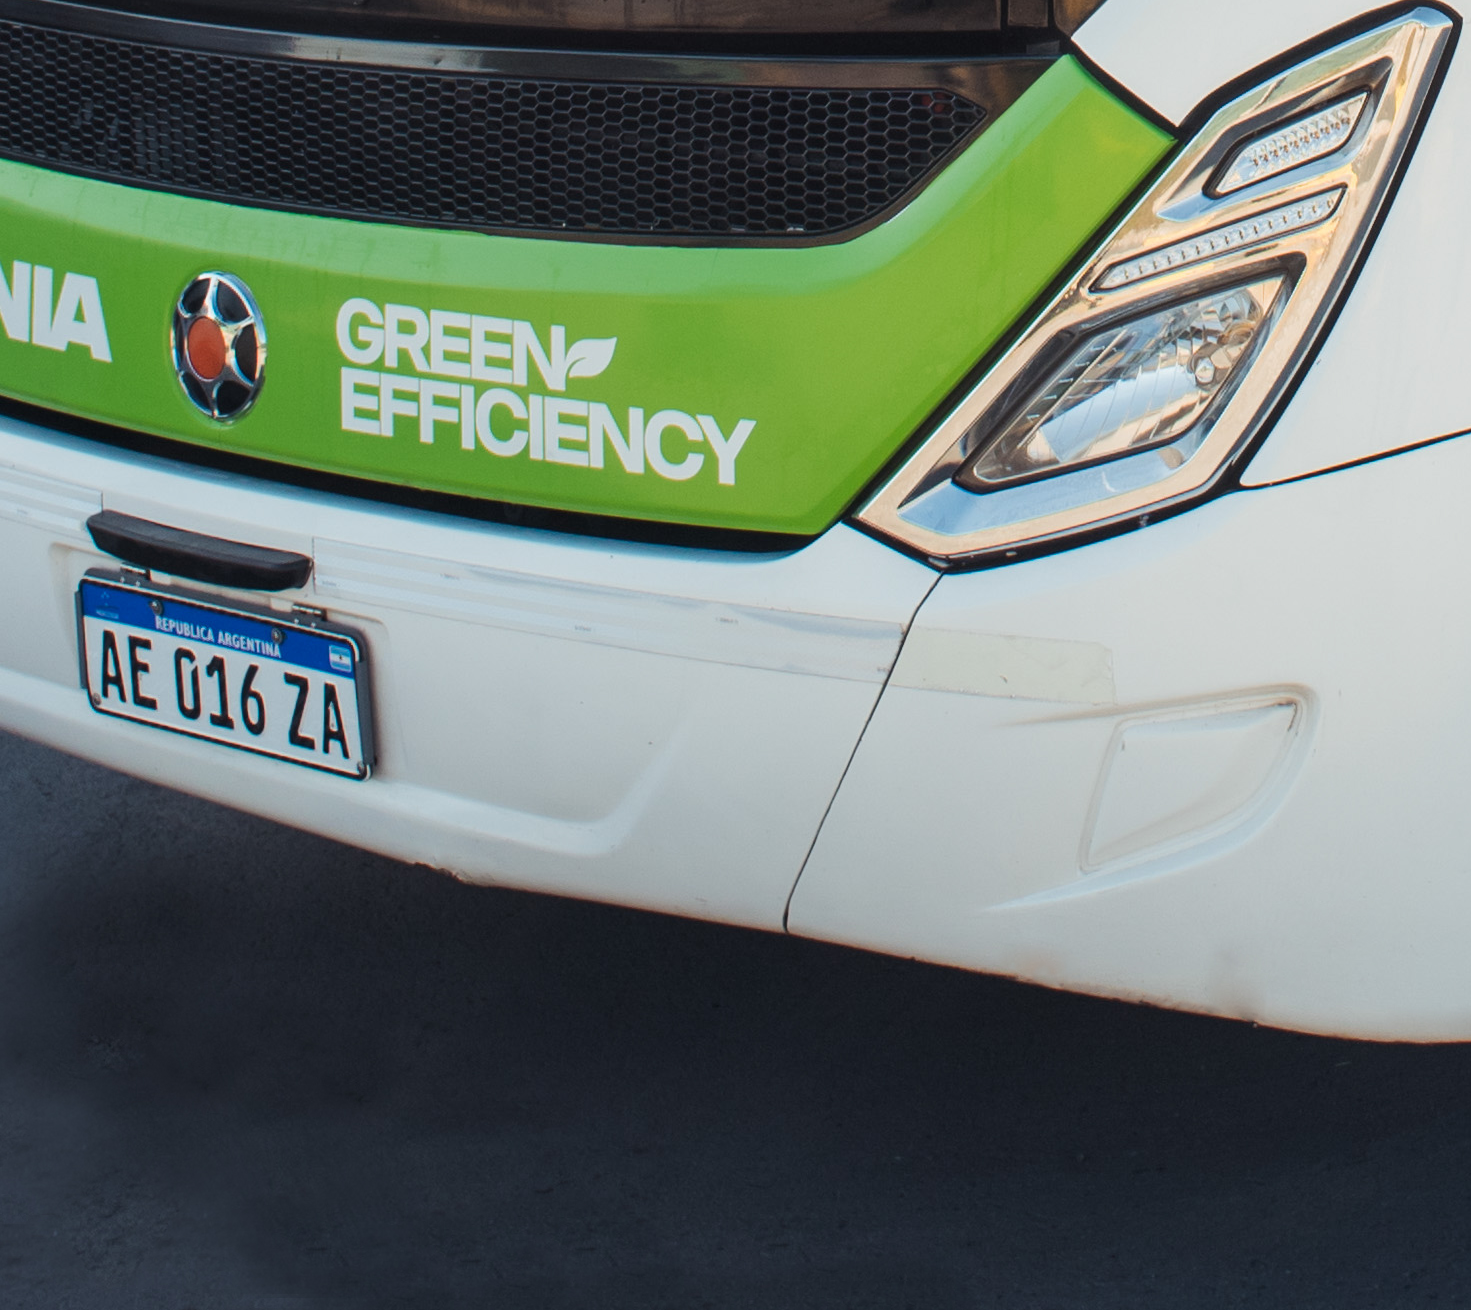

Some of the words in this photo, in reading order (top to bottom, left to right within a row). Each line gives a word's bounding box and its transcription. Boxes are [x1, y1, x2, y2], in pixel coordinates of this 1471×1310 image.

[335, 297, 568, 392] GREEN
[339, 366, 758, 488] EFFICIENCY
[154, 615, 215, 643] REPUBLICA
[217, 630, 282, 659] ARGENTINA
[101, 628, 158, 711] AE
[174, 646, 267, 736] 016
[283, 672, 351, 760] ZA
